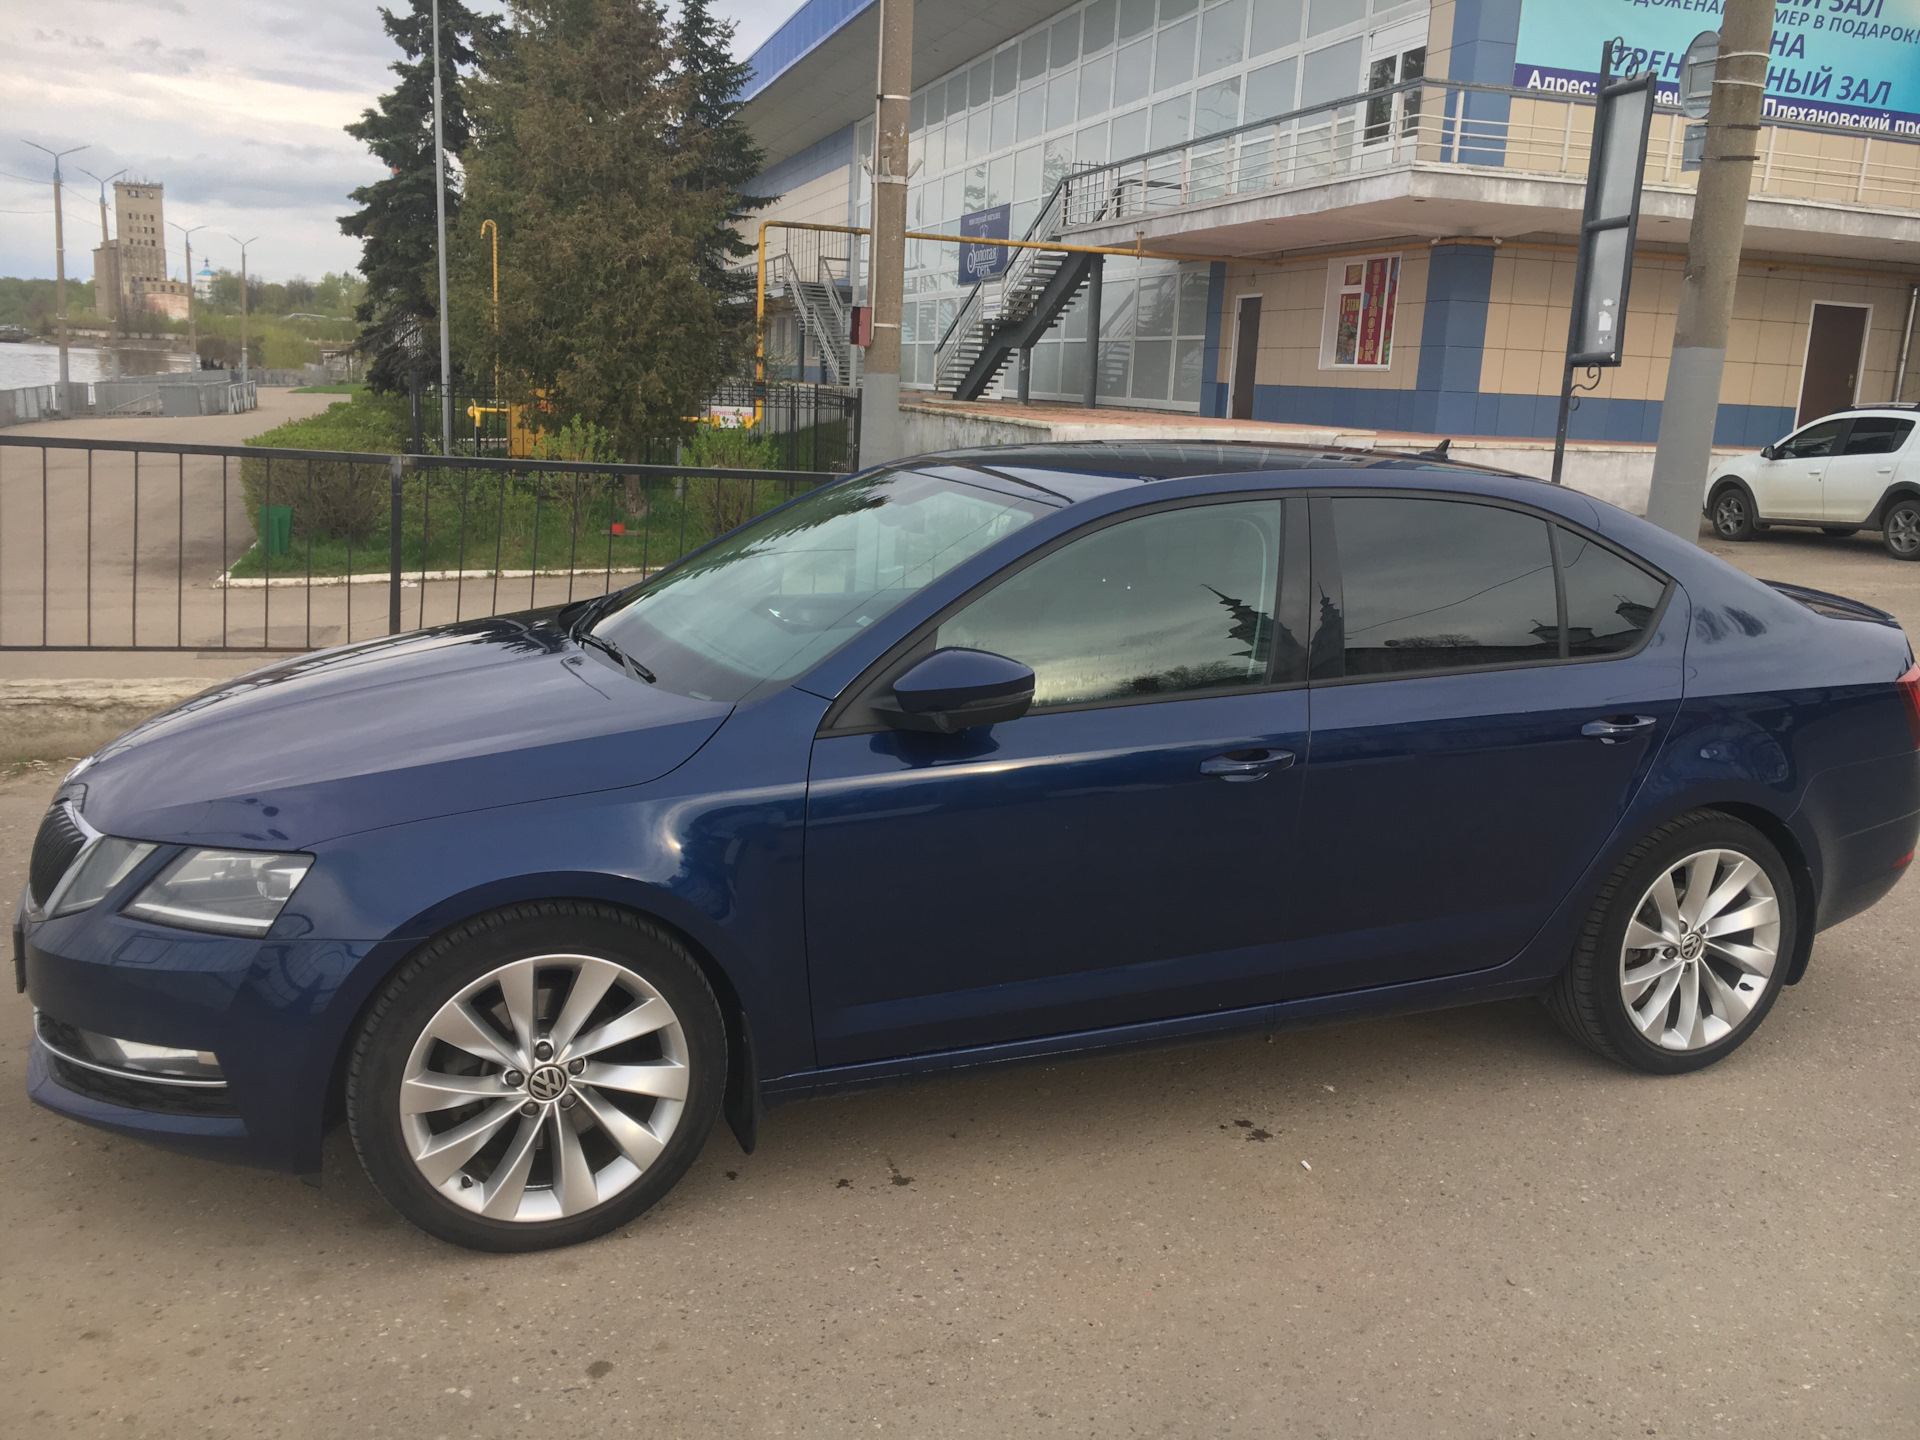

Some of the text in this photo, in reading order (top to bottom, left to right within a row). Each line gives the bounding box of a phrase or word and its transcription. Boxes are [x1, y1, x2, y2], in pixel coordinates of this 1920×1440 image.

[1774, 8, 1810, 27] МЕР
[1813, 14, 1825, 29] В
[1769, 30, 1805, 59] НА
[1765, 65, 1833, 98] НЫЙ
[1836, 75, 1892, 106] ЗАЛ
[1762, 98, 1890, 131] Плехановский
